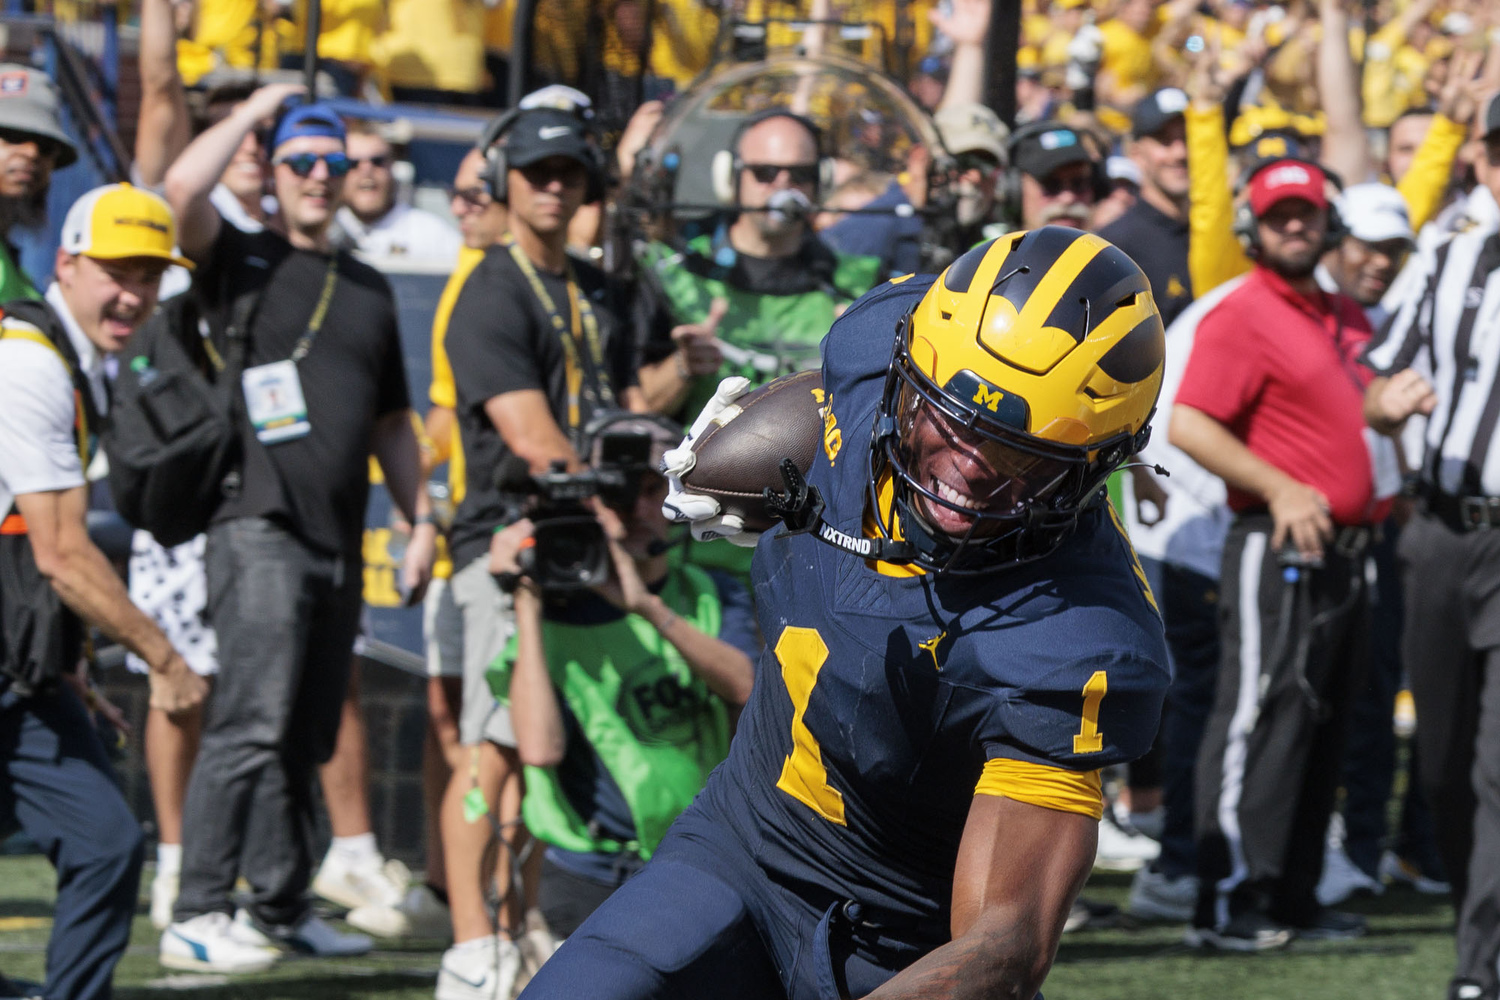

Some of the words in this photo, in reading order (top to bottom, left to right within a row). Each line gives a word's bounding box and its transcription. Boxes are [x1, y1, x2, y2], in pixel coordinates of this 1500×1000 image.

[972, 383, 1004, 412] M
[819, 523, 871, 555] NXTRND
[775, 626, 847, 826] 1
[1074, 671, 1103, 754] 1
